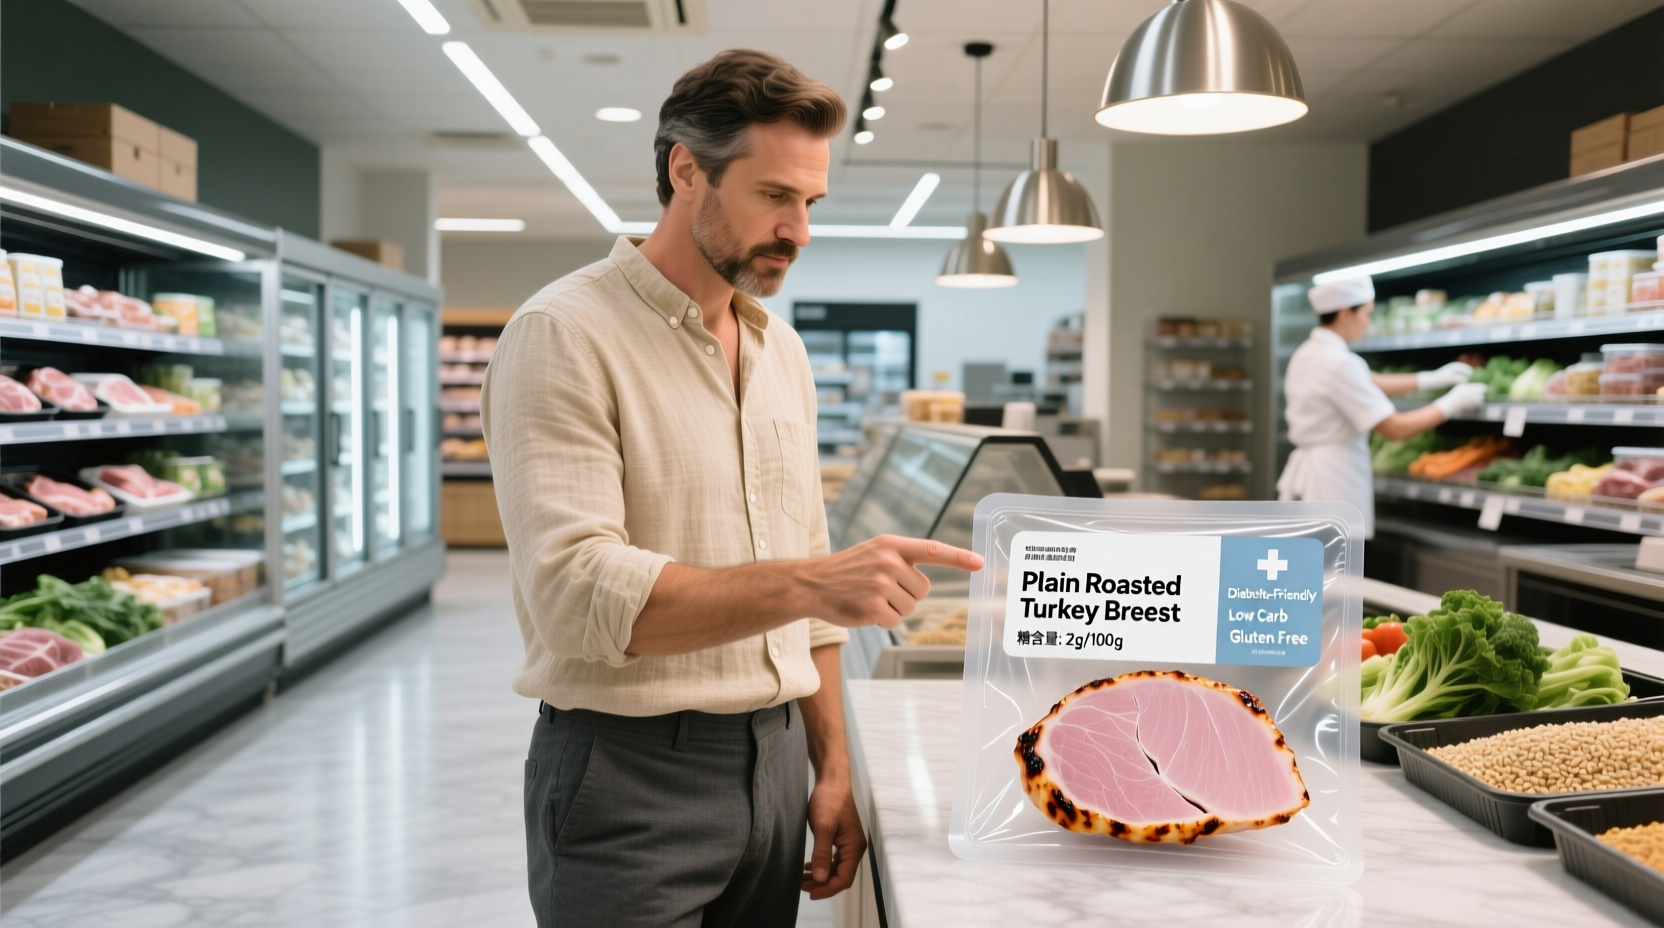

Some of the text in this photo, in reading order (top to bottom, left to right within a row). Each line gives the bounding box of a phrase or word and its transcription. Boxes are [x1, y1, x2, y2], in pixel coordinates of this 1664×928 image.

[1021, 570, 1182, 596] Plain Roasted
[1020, 597, 1181, 625] Turkey Breest
[1228, 608, 1289, 623] Low Carb
[1065, 632, 1124, 650] 2g/100g
[1229, 629, 1309, 645] Gluten Free
